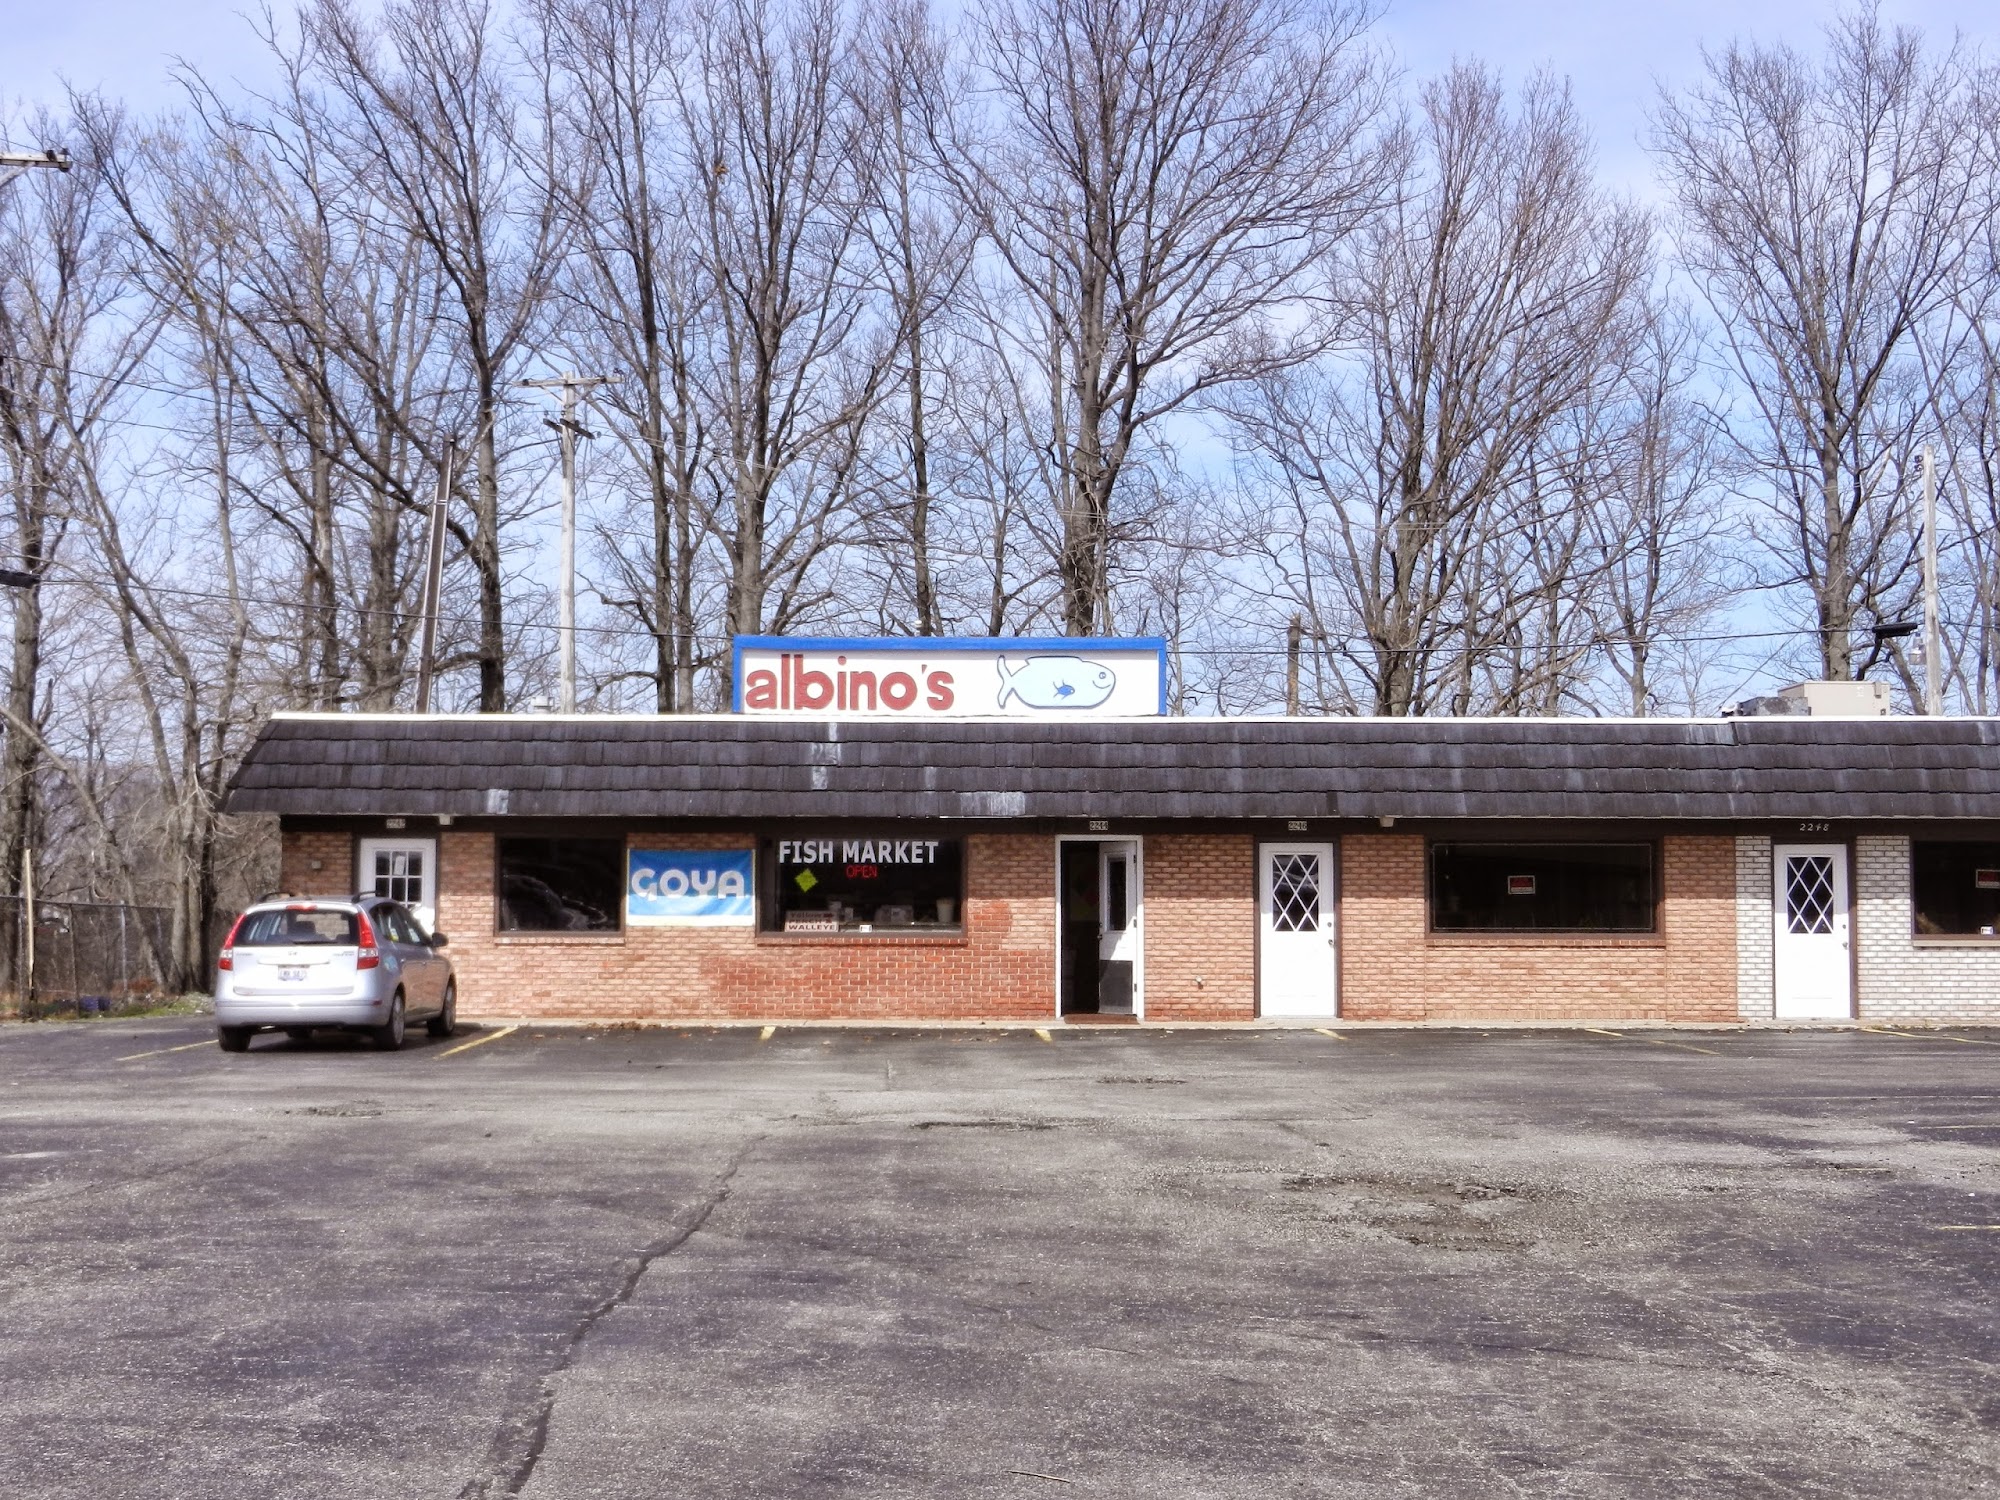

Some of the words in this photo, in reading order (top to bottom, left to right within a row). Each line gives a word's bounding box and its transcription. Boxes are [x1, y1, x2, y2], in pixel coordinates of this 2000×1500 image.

[745, 654, 955, 711] albino's
[1800, 823, 1830, 831] 2248
[779, 841, 834, 864] FISH
[842, 841, 939, 864] MARKET
[846, 865, 877, 878] OPEN
[631, 868, 745, 901] GOYA
